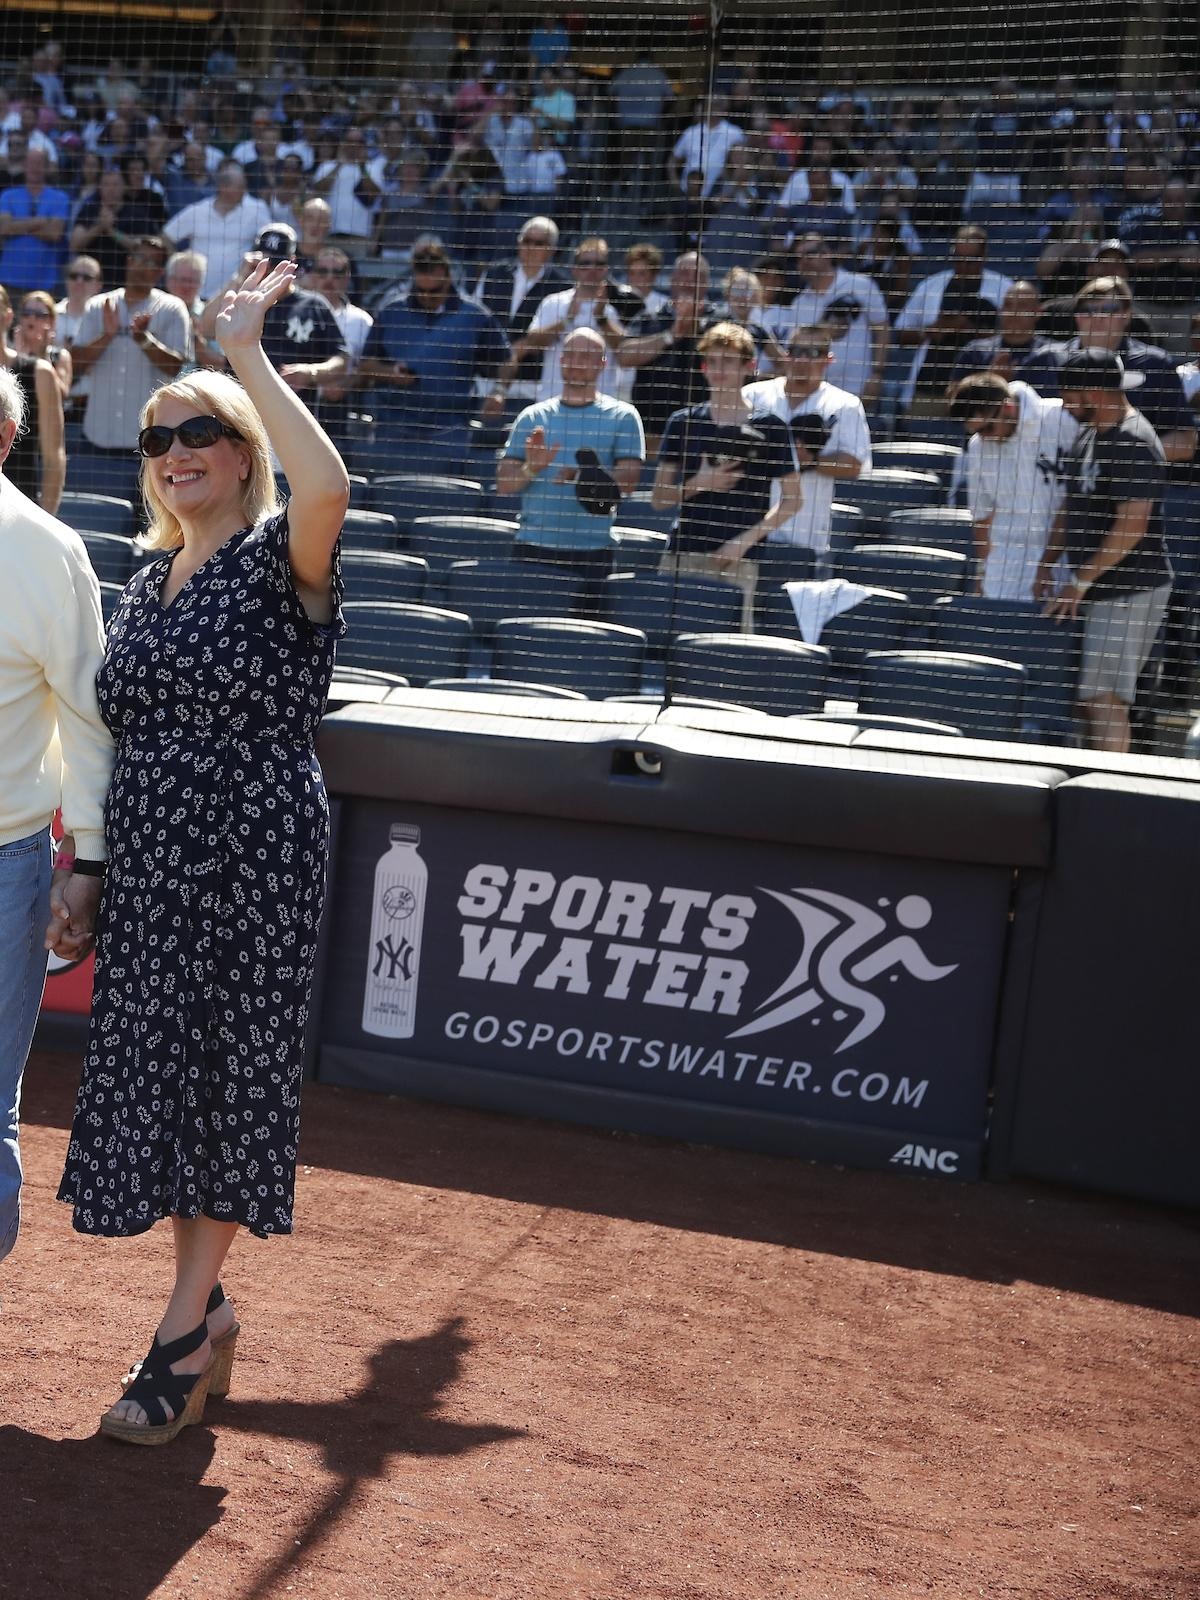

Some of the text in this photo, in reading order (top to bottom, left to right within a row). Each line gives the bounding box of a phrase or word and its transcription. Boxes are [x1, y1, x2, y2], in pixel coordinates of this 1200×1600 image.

[456, 863, 758, 951] SPORTS
[457, 923, 751, 1016] WATER
[443, 1010, 929, 1109] GOSPORTSWATER.COM
[889, 1143, 960, 1174] ANC
